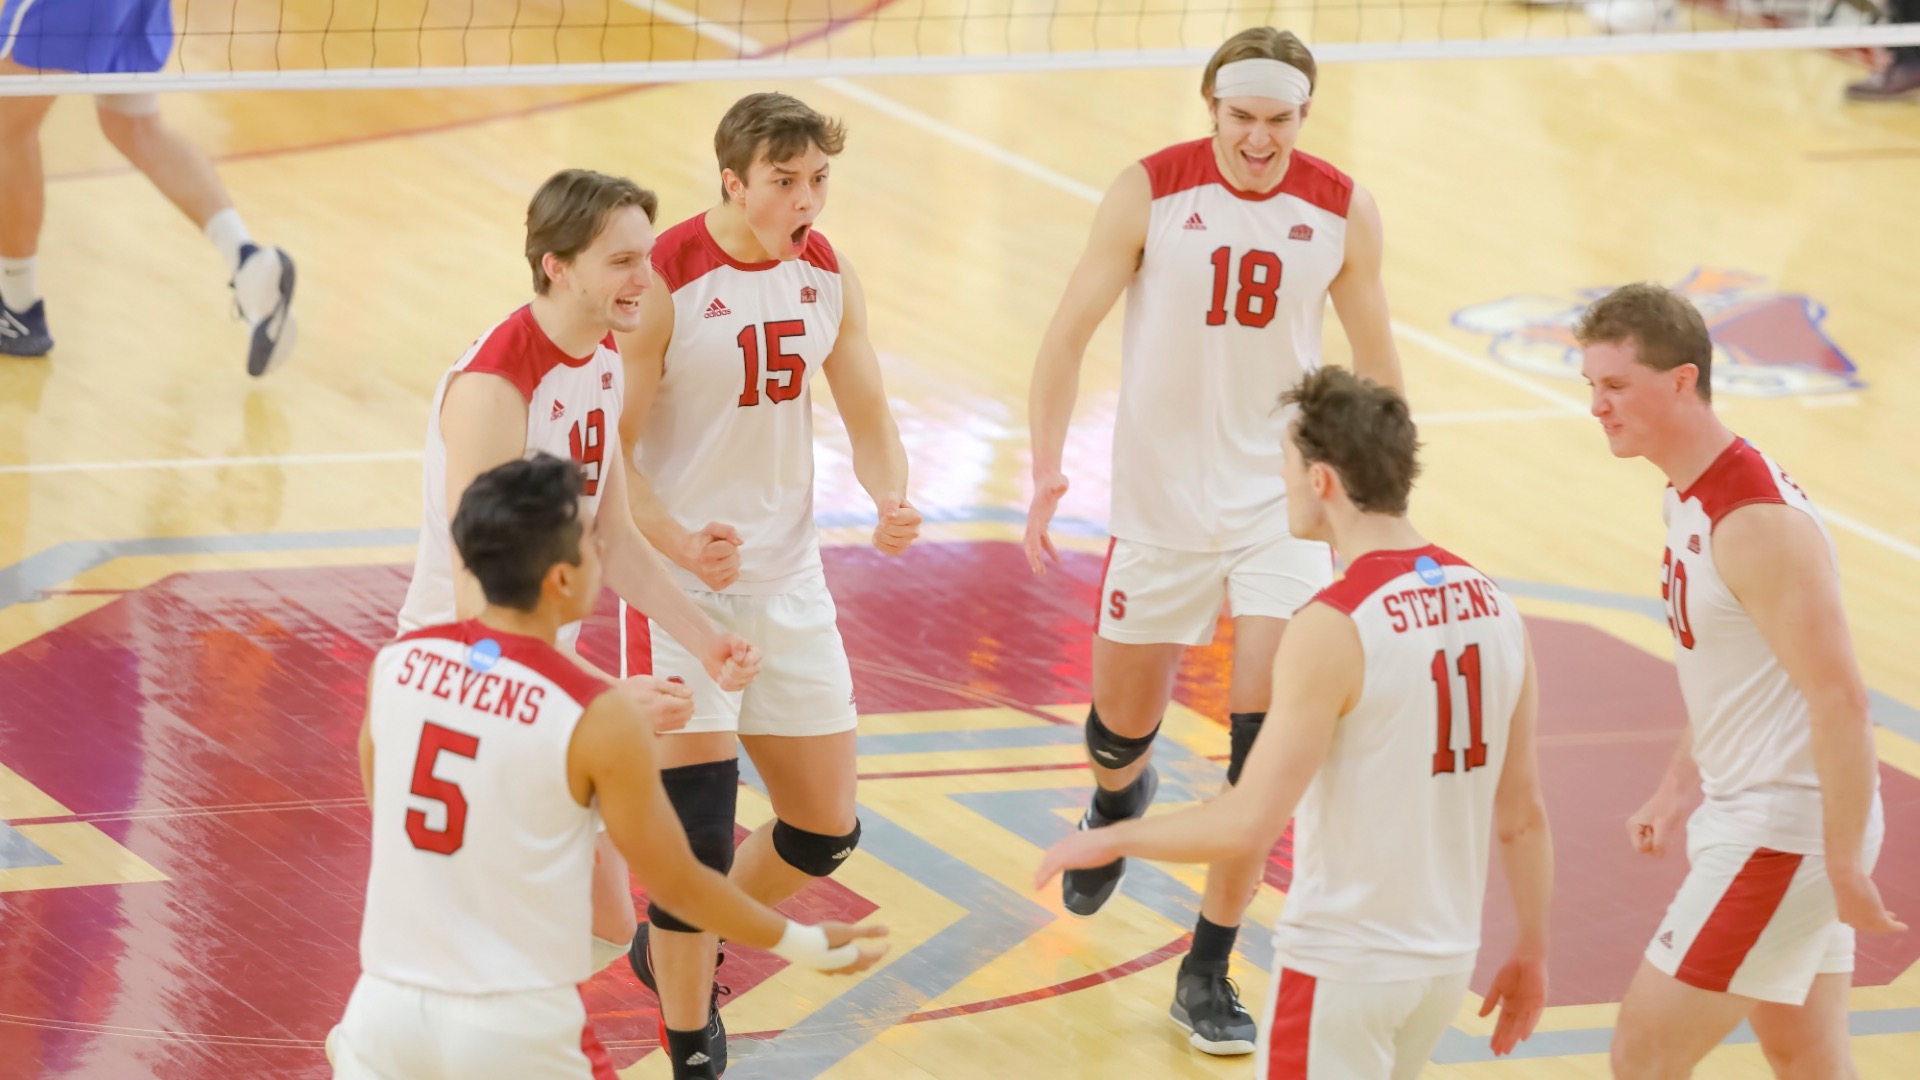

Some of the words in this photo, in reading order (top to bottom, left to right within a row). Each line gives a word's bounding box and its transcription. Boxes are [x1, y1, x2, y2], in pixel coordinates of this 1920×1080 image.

[703, 308, 732, 319] adidas
[1206, 245, 1282, 329] 18
[737, 319, 807, 408] 15
[1108, 589, 1128, 621] S
[1383, 578, 1500, 634] STEVENS
[397, 647, 546, 726] STEVENS
[1431, 643, 1488, 777] 11
[404, 720, 480, 857] 5
